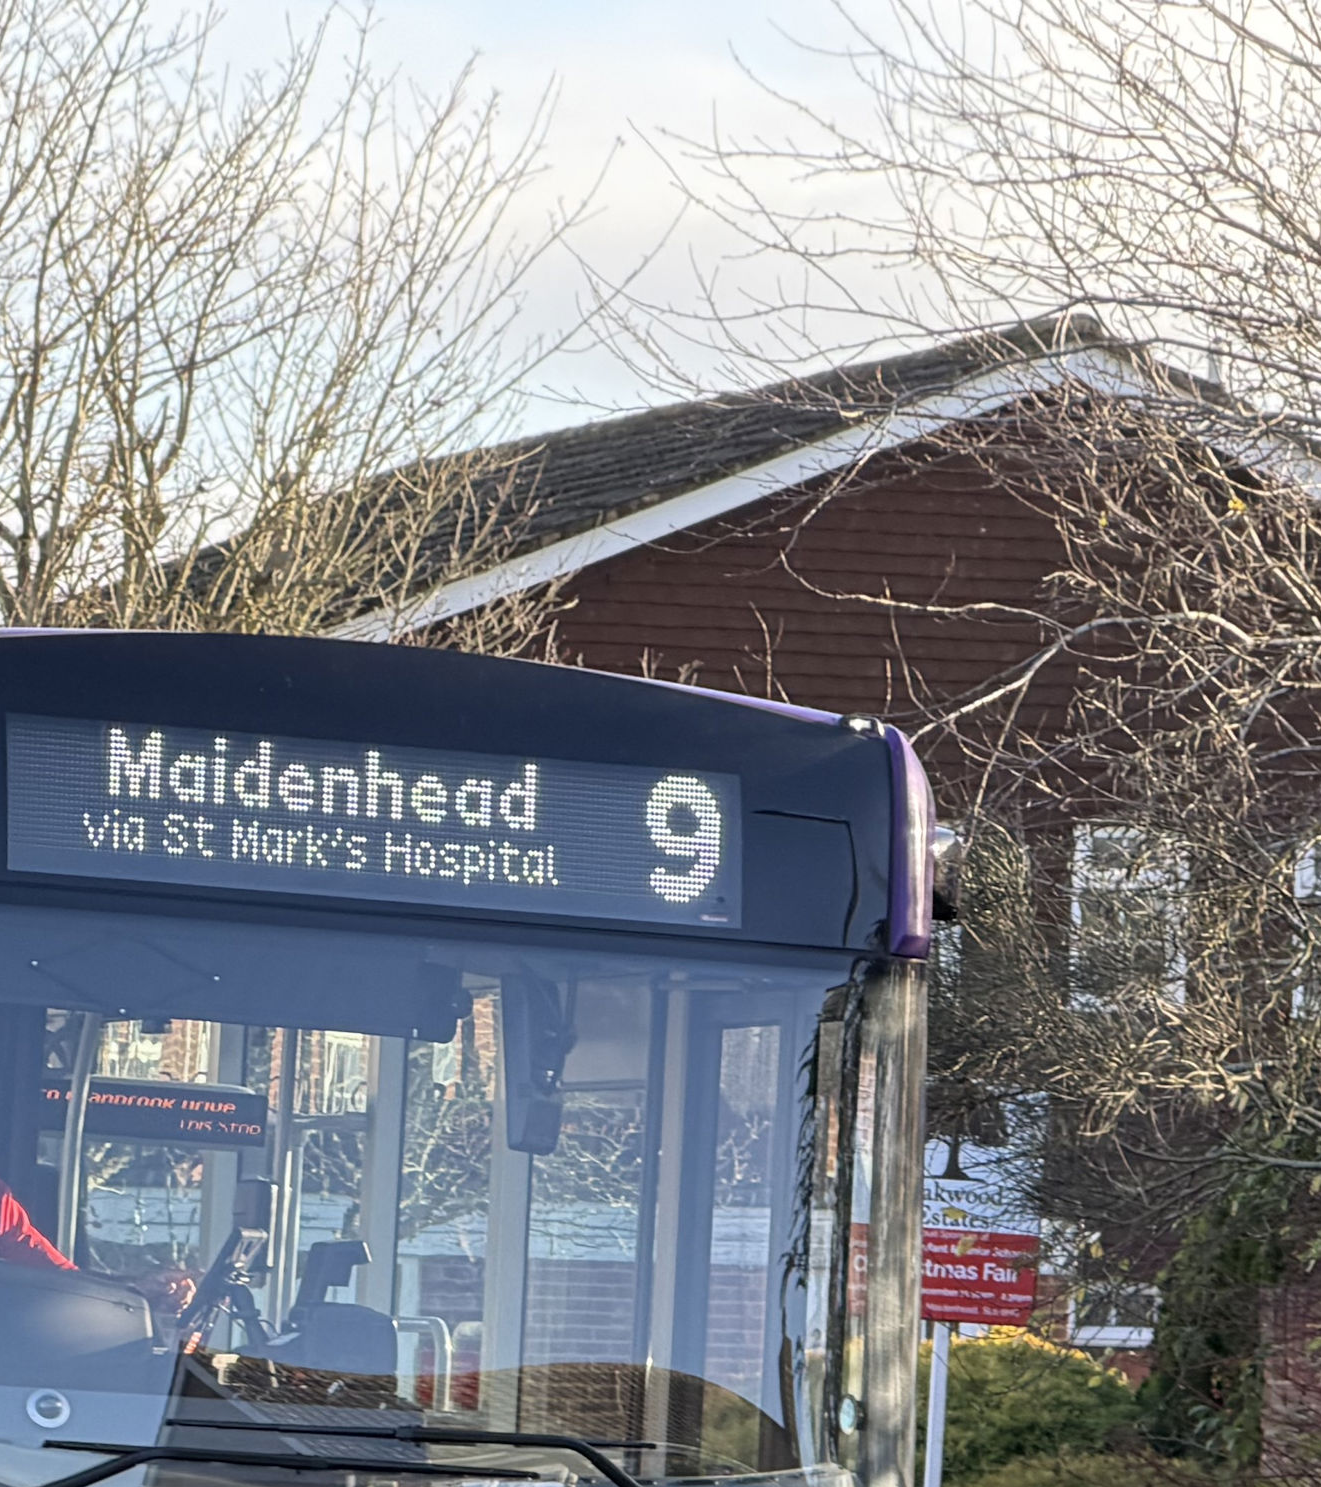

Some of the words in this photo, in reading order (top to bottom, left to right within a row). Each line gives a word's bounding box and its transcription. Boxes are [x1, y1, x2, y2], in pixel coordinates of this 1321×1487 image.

[109, 727, 537, 831] Maidenhead
[81, 808, 145, 852] via
[162, 813, 214, 857] St
[232, 817, 368, 870] Mark's
[384, 831, 559, 886] Hospital
[645, 774, 722, 903] 9
[922, 1180, 1003, 1206] akwood
